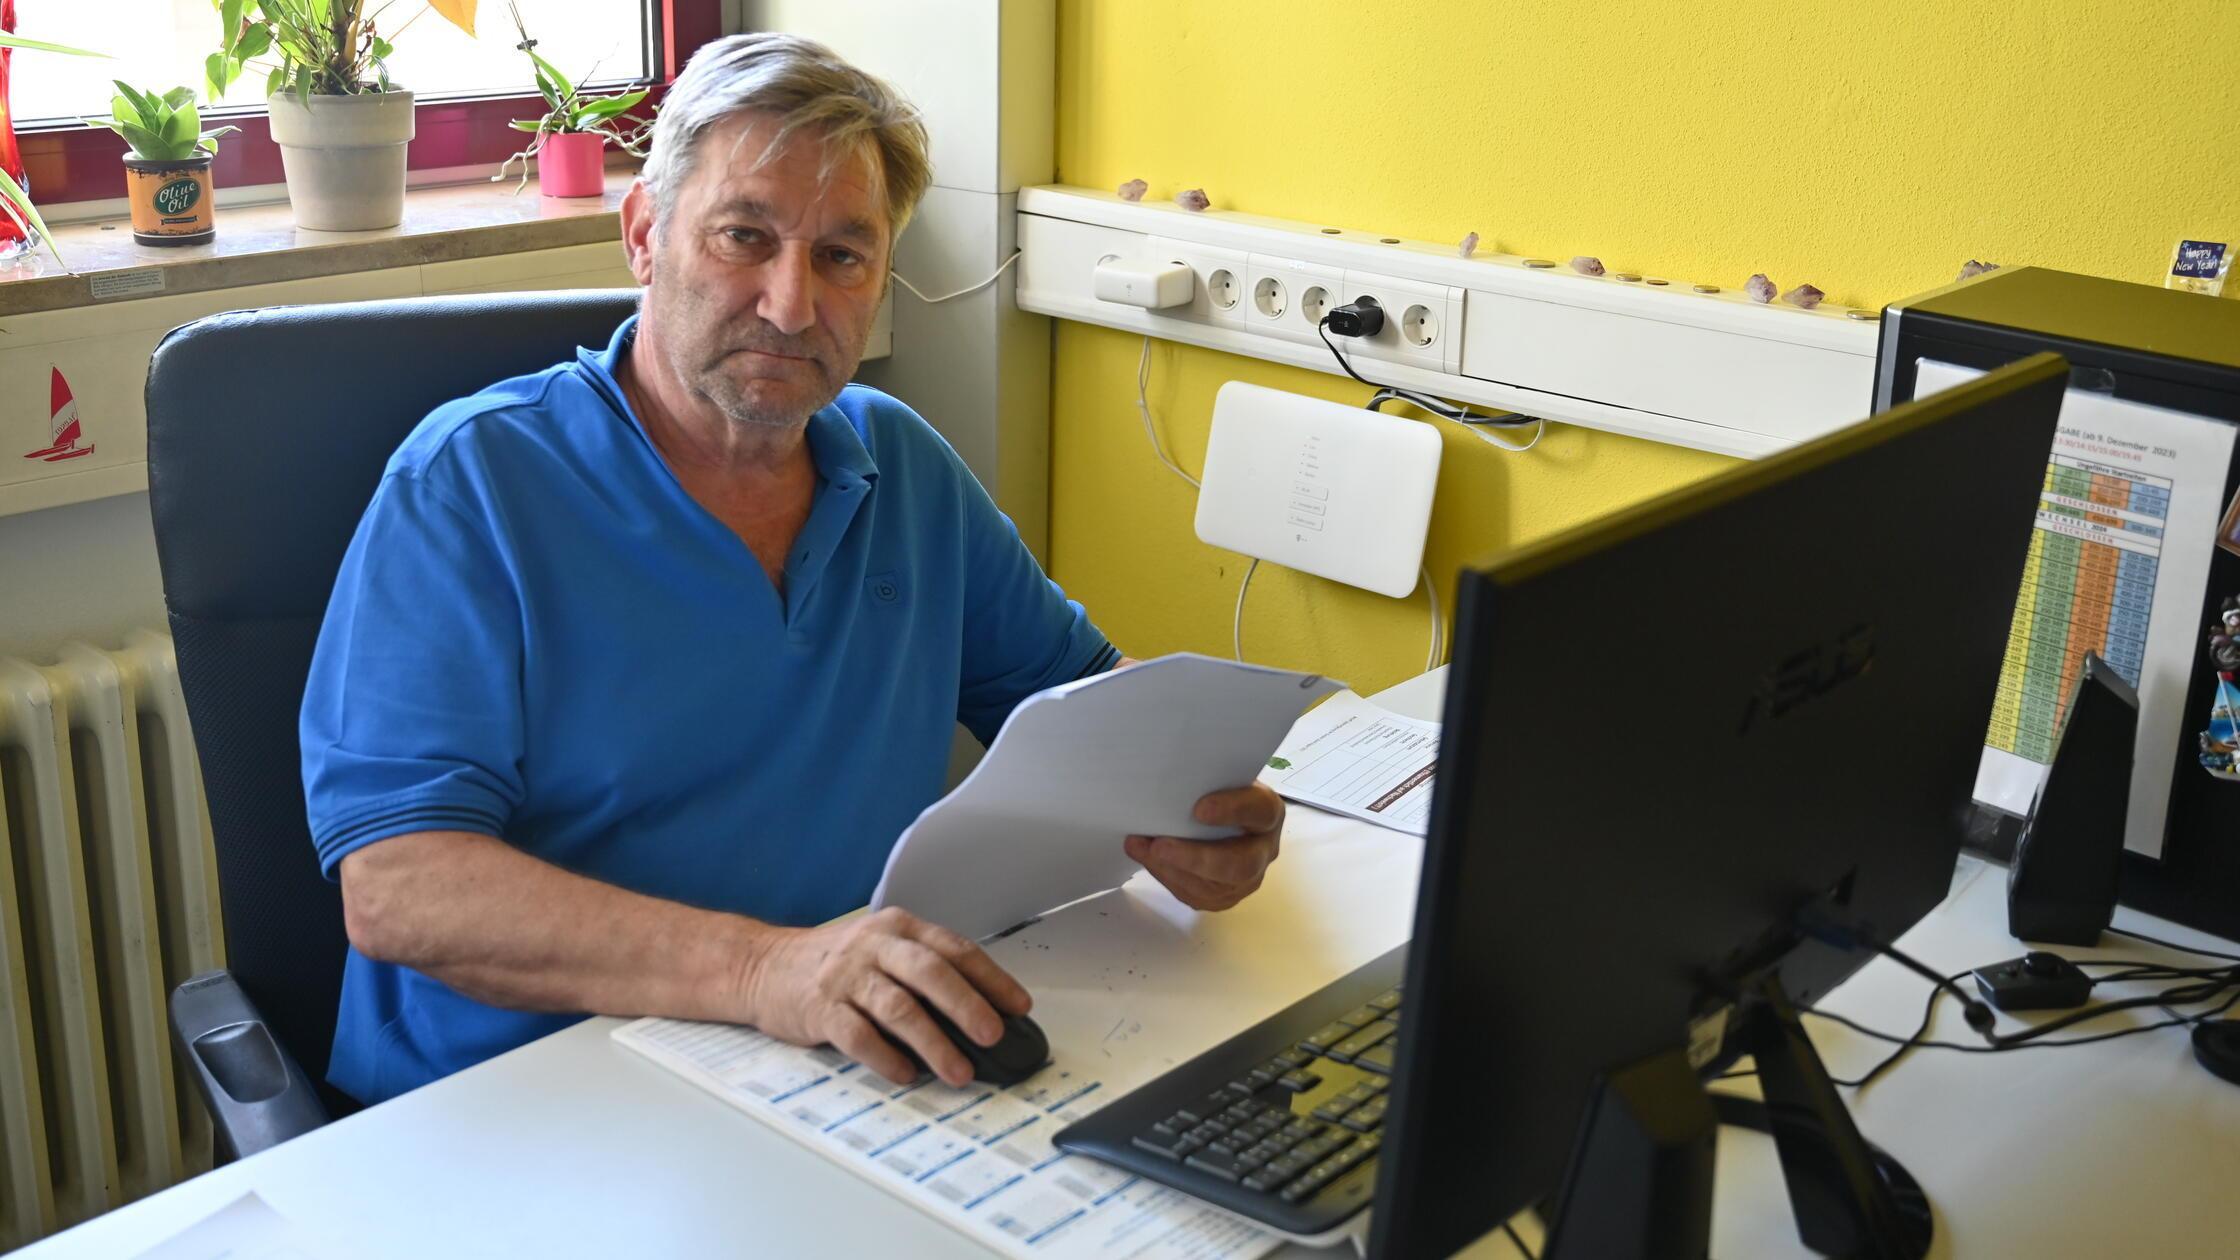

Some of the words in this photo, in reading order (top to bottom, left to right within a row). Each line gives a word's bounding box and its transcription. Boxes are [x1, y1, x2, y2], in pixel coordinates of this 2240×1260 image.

[159, 182, 196, 203] Olive
[168, 194, 189, 213] Oil
[2185, 248, 2211, 259] Happy
[2175, 261, 2193, 271] New
[2055, 426, 2080, 437] GABE
[2107, 436, 2148, 451] Dezember
[2152, 446, 2177, 460] 2023)
